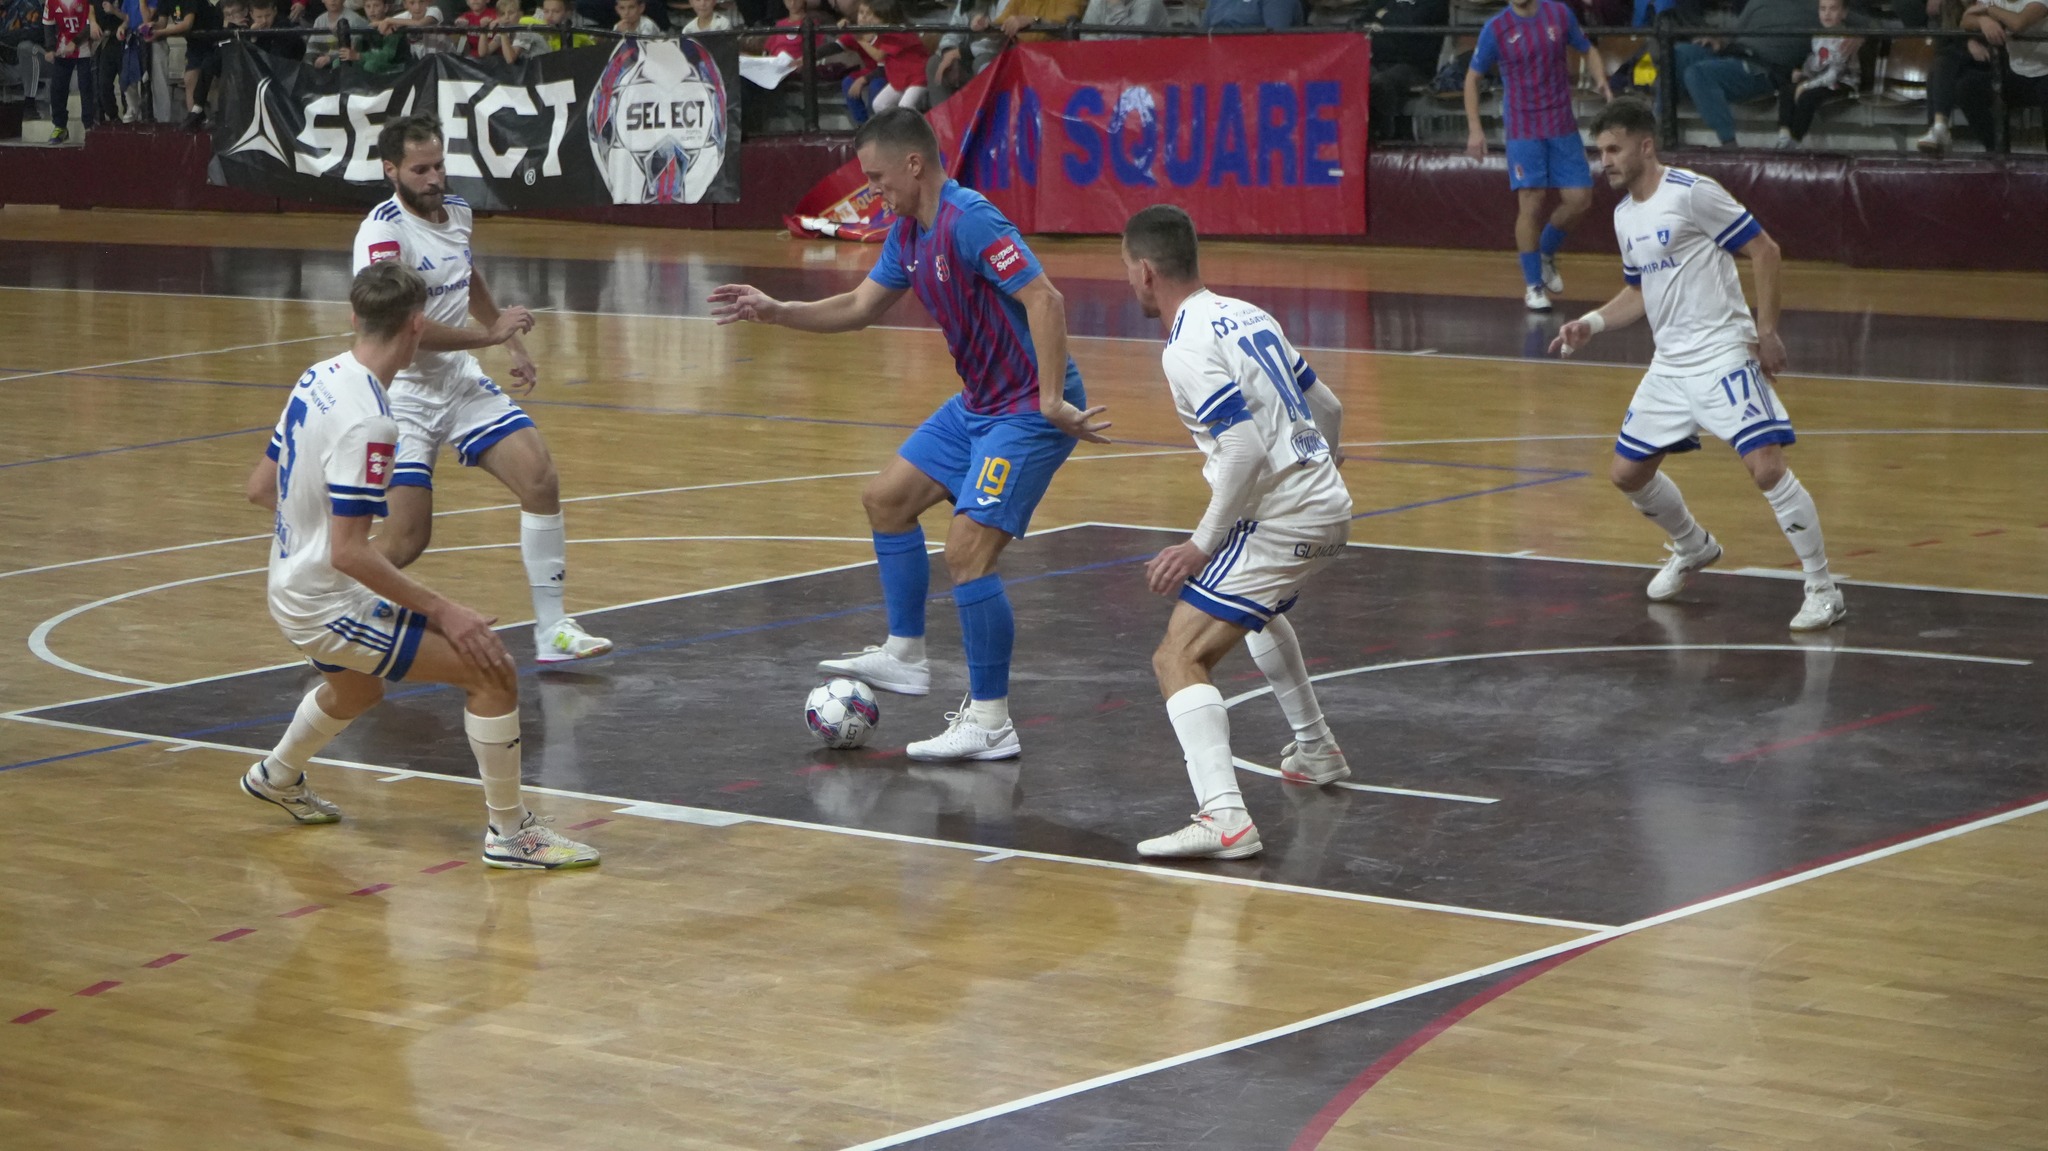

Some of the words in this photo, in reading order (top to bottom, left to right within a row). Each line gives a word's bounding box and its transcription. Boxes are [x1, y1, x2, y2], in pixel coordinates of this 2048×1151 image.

[294, 79, 577, 182] SEECT
[626, 101, 705, 131] SELECT
[1063, 81, 1342, 187] SQUARE
[989, 243, 1014, 265] Super
[996, 251, 1020, 272] Sport
[1237, 328, 1313, 423] 10
[1721, 369, 1750, 407] 17
[975, 456, 1011, 496] 19
